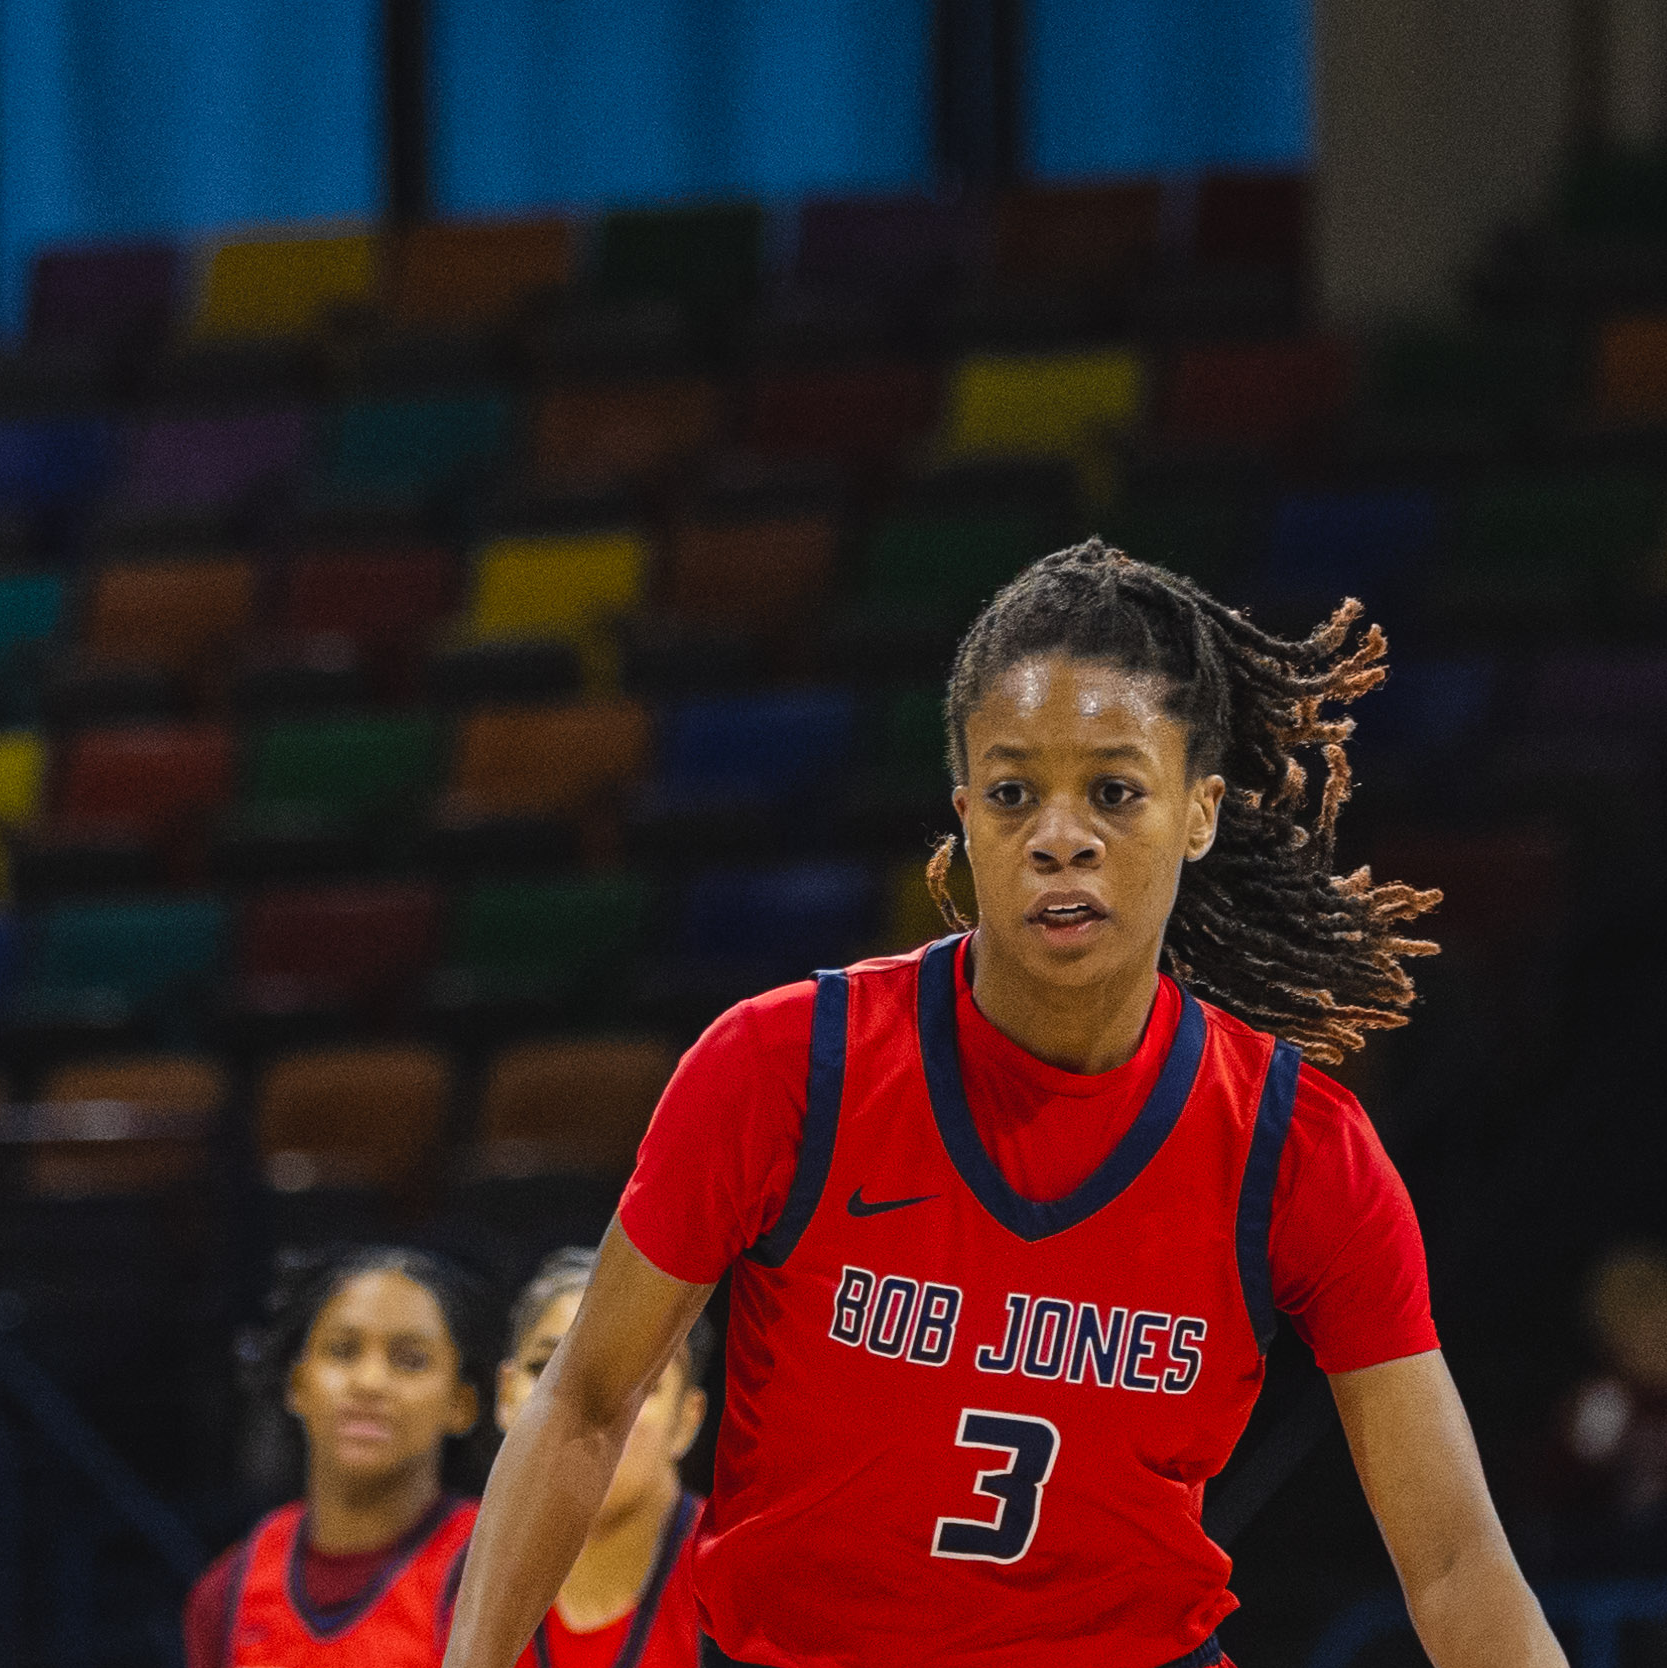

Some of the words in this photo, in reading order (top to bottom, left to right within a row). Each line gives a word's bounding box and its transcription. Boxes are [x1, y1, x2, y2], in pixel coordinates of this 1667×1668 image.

[828, 1265, 963, 1367] BOB
[975, 1293, 1208, 1394] JONES
[930, 1408, 1060, 1565] 3
